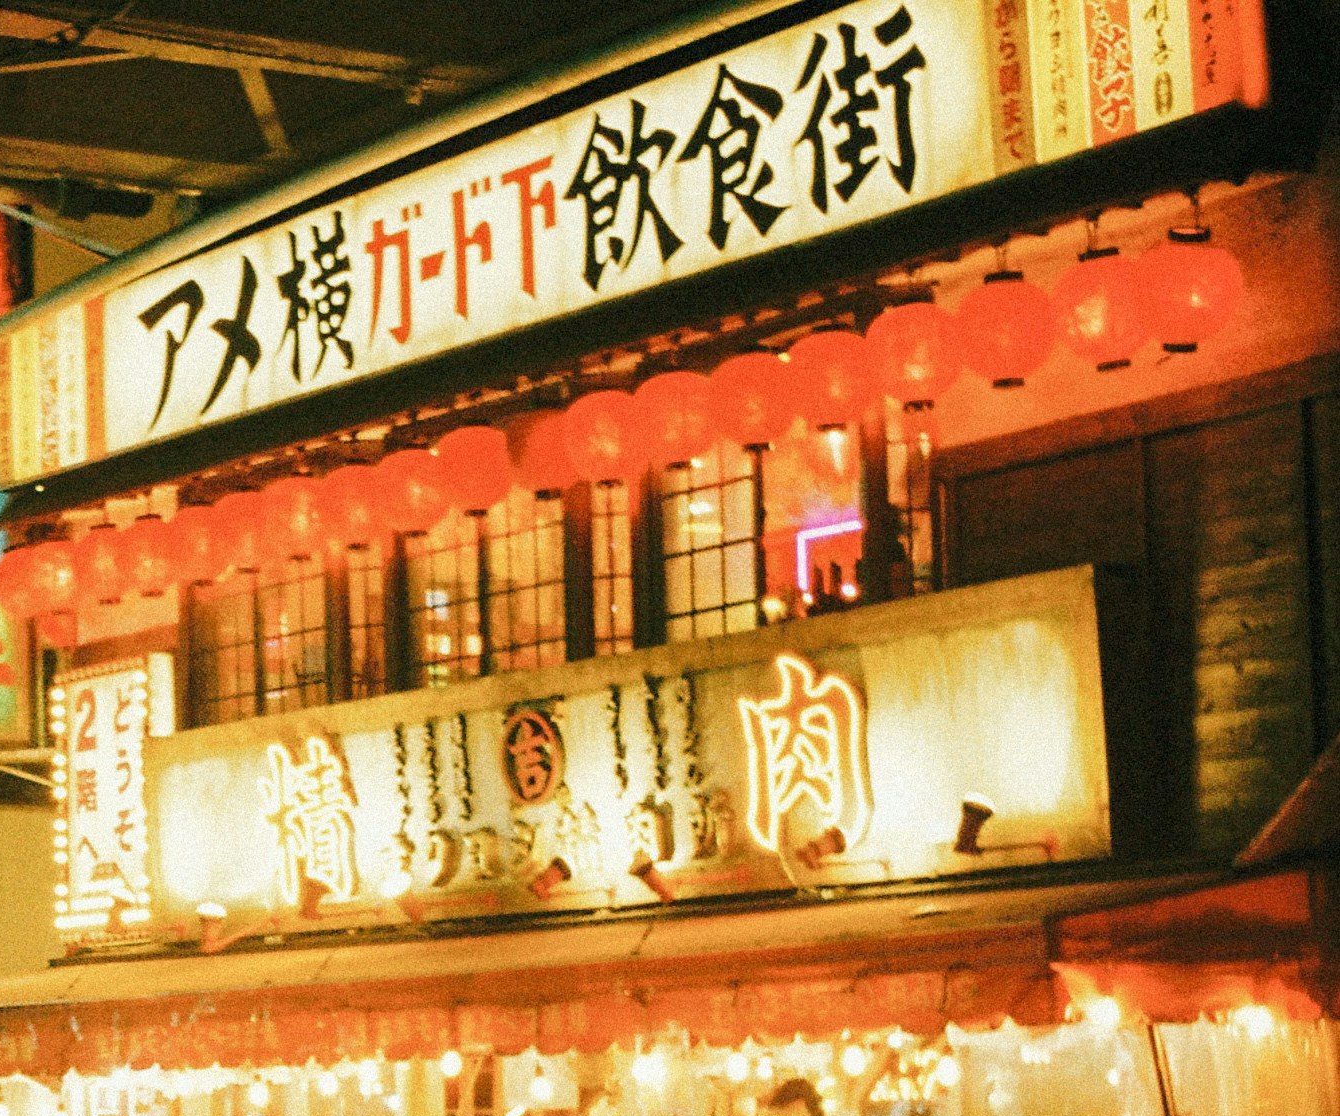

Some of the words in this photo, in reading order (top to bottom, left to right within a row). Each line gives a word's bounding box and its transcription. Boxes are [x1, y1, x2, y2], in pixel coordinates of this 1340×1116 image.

[137, 4, 927, 430] アメ横ガード下飲食街
[738, 655, 876, 853] 肉
